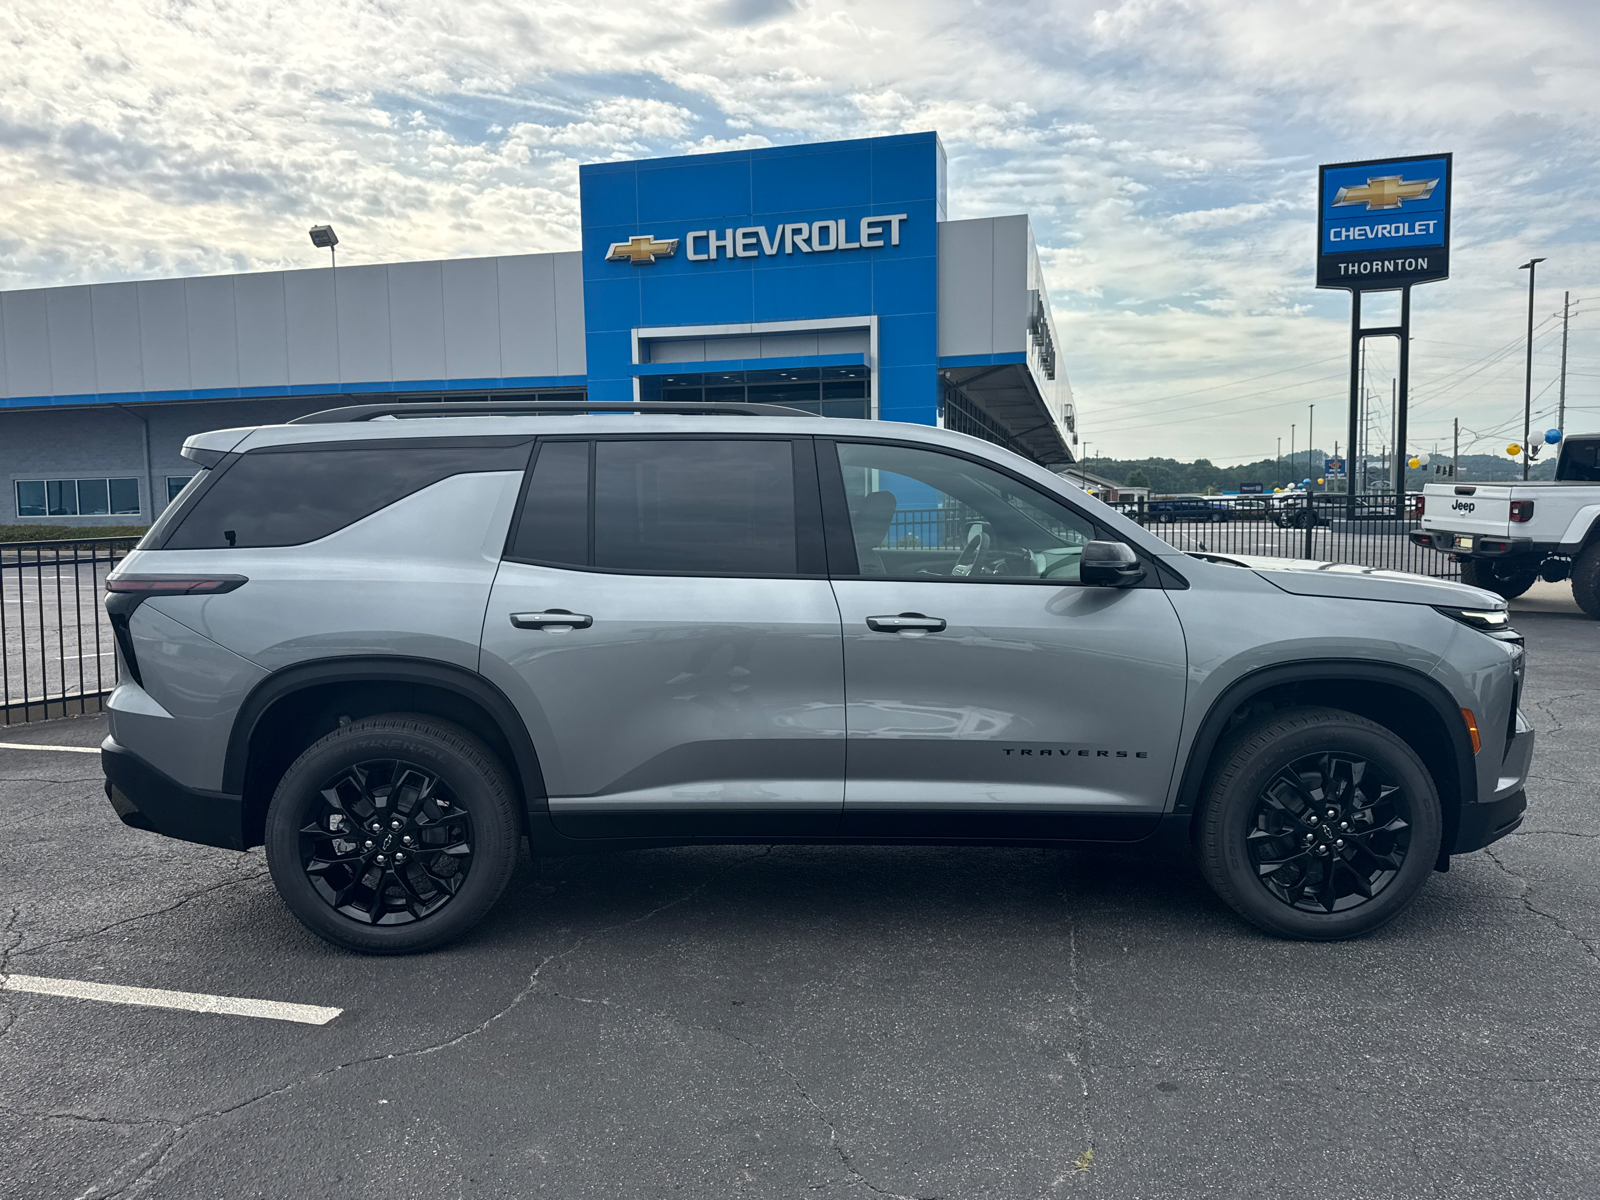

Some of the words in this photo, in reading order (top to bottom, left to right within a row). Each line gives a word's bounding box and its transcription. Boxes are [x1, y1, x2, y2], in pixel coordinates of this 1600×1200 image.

[686, 213, 907, 262] CHEVROLET
[1330, 220, 1438, 242] CHEVROLET
[1338, 257, 1428, 276] THORNTON
[1451, 499, 1475, 513] Jeep
[1002, 749, 1148, 759] TRAVERSE
